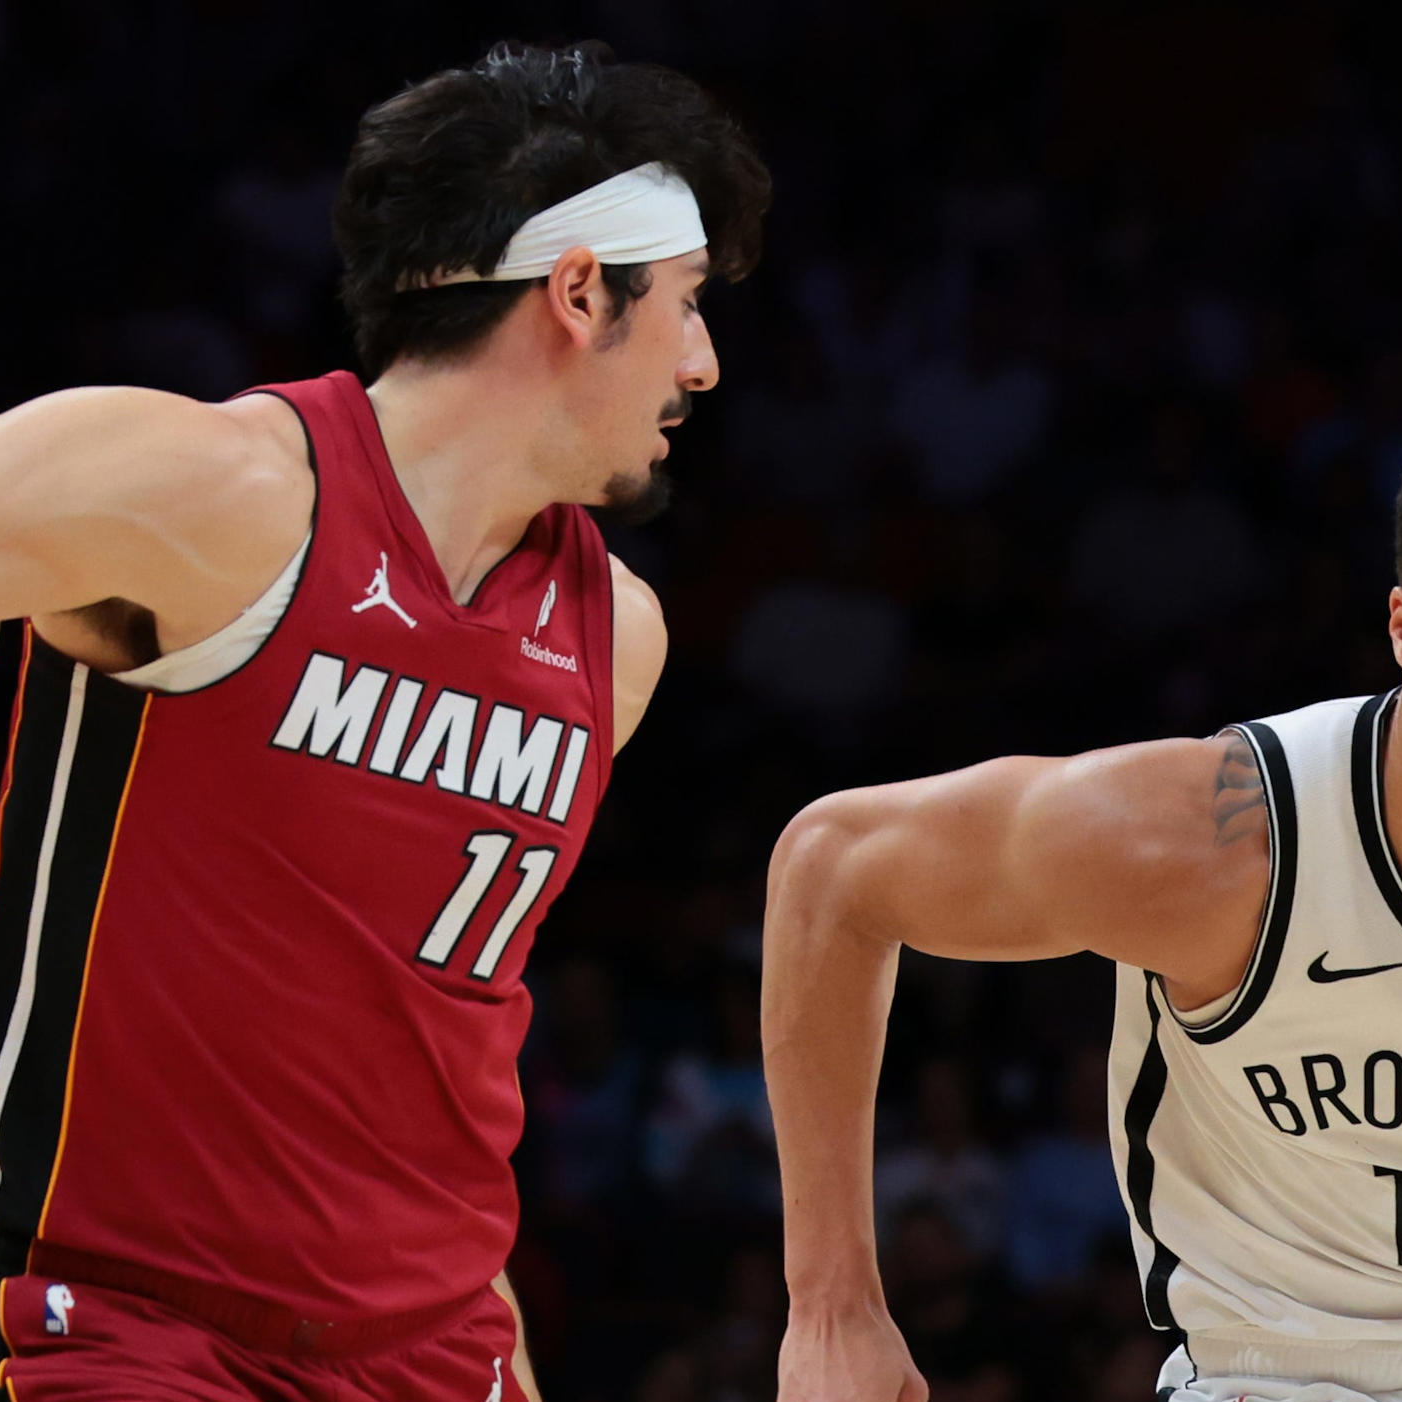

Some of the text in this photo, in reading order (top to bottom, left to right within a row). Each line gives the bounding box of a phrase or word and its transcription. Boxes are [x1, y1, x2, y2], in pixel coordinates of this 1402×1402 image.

[520, 636, 578, 673] Robinhood
[269, 650, 590, 826] MIAMI
[415, 829, 560, 984] 11
